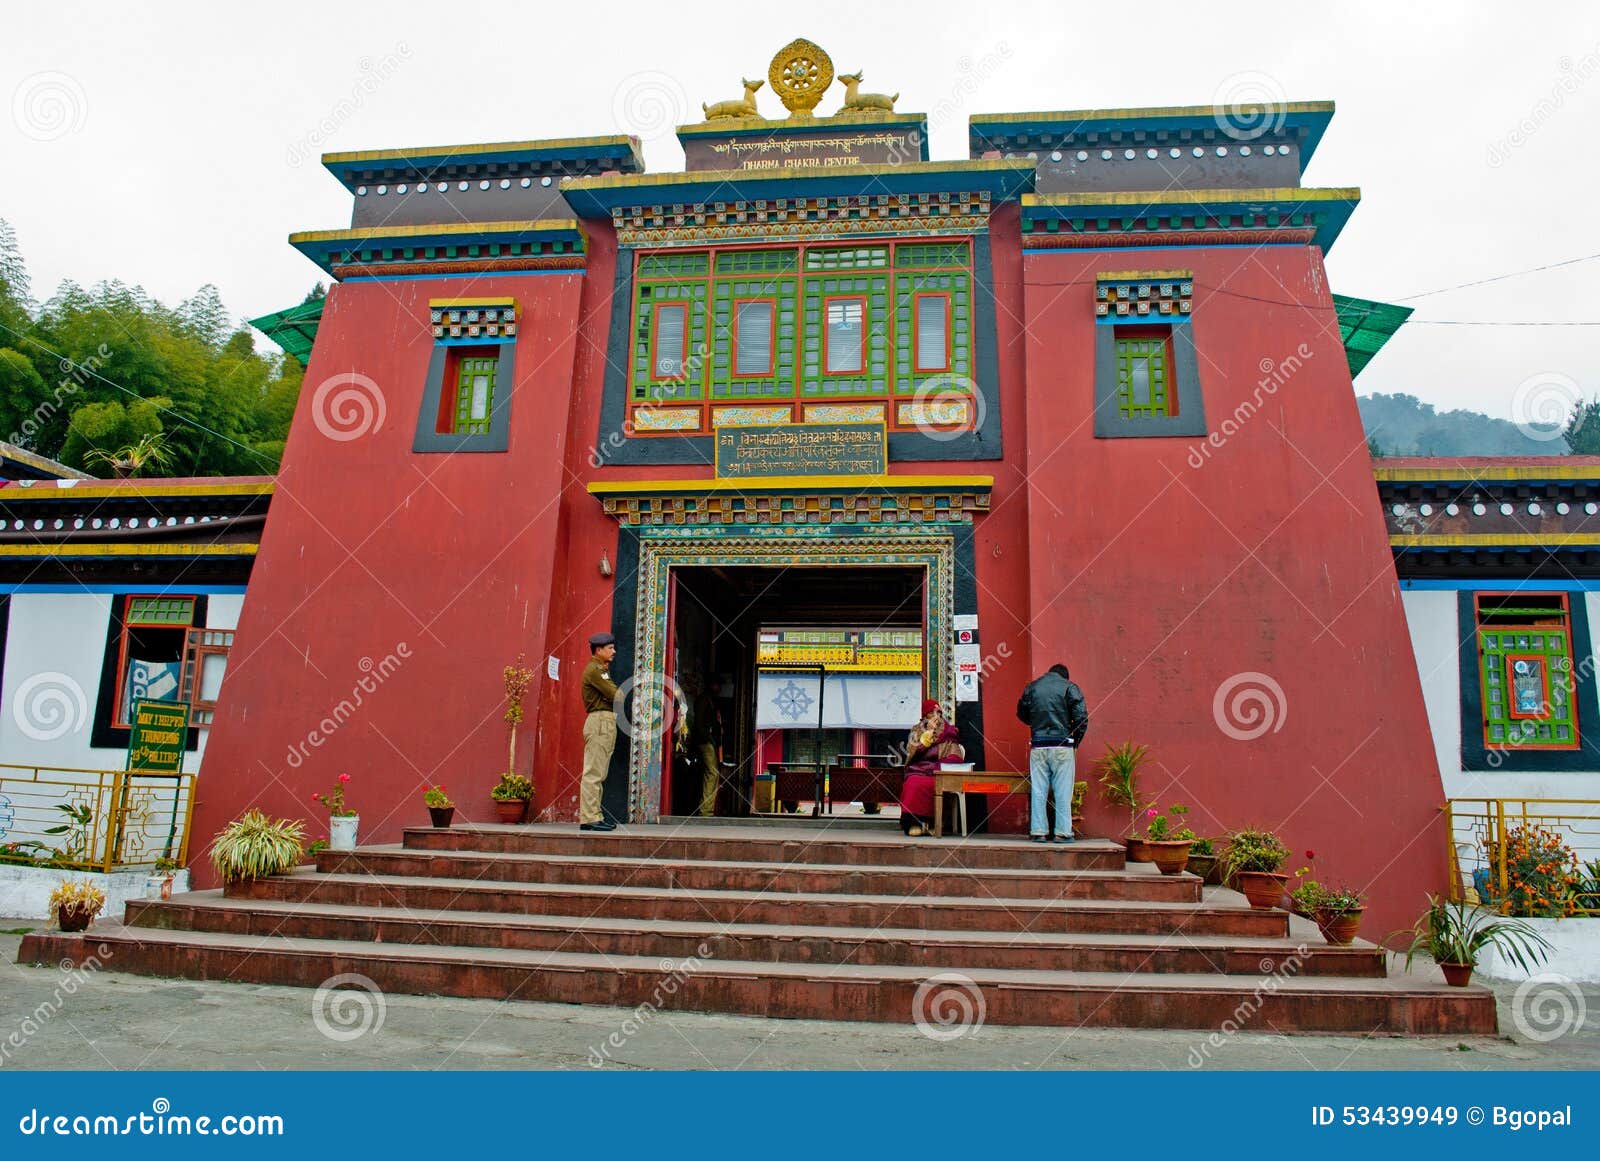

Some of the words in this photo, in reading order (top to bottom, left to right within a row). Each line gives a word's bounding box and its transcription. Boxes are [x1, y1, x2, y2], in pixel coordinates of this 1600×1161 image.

[743, 159, 780, 171] DHARMA
[784, 157, 821, 168] CHAKRA
[824, 156, 860, 167] CENTRE
